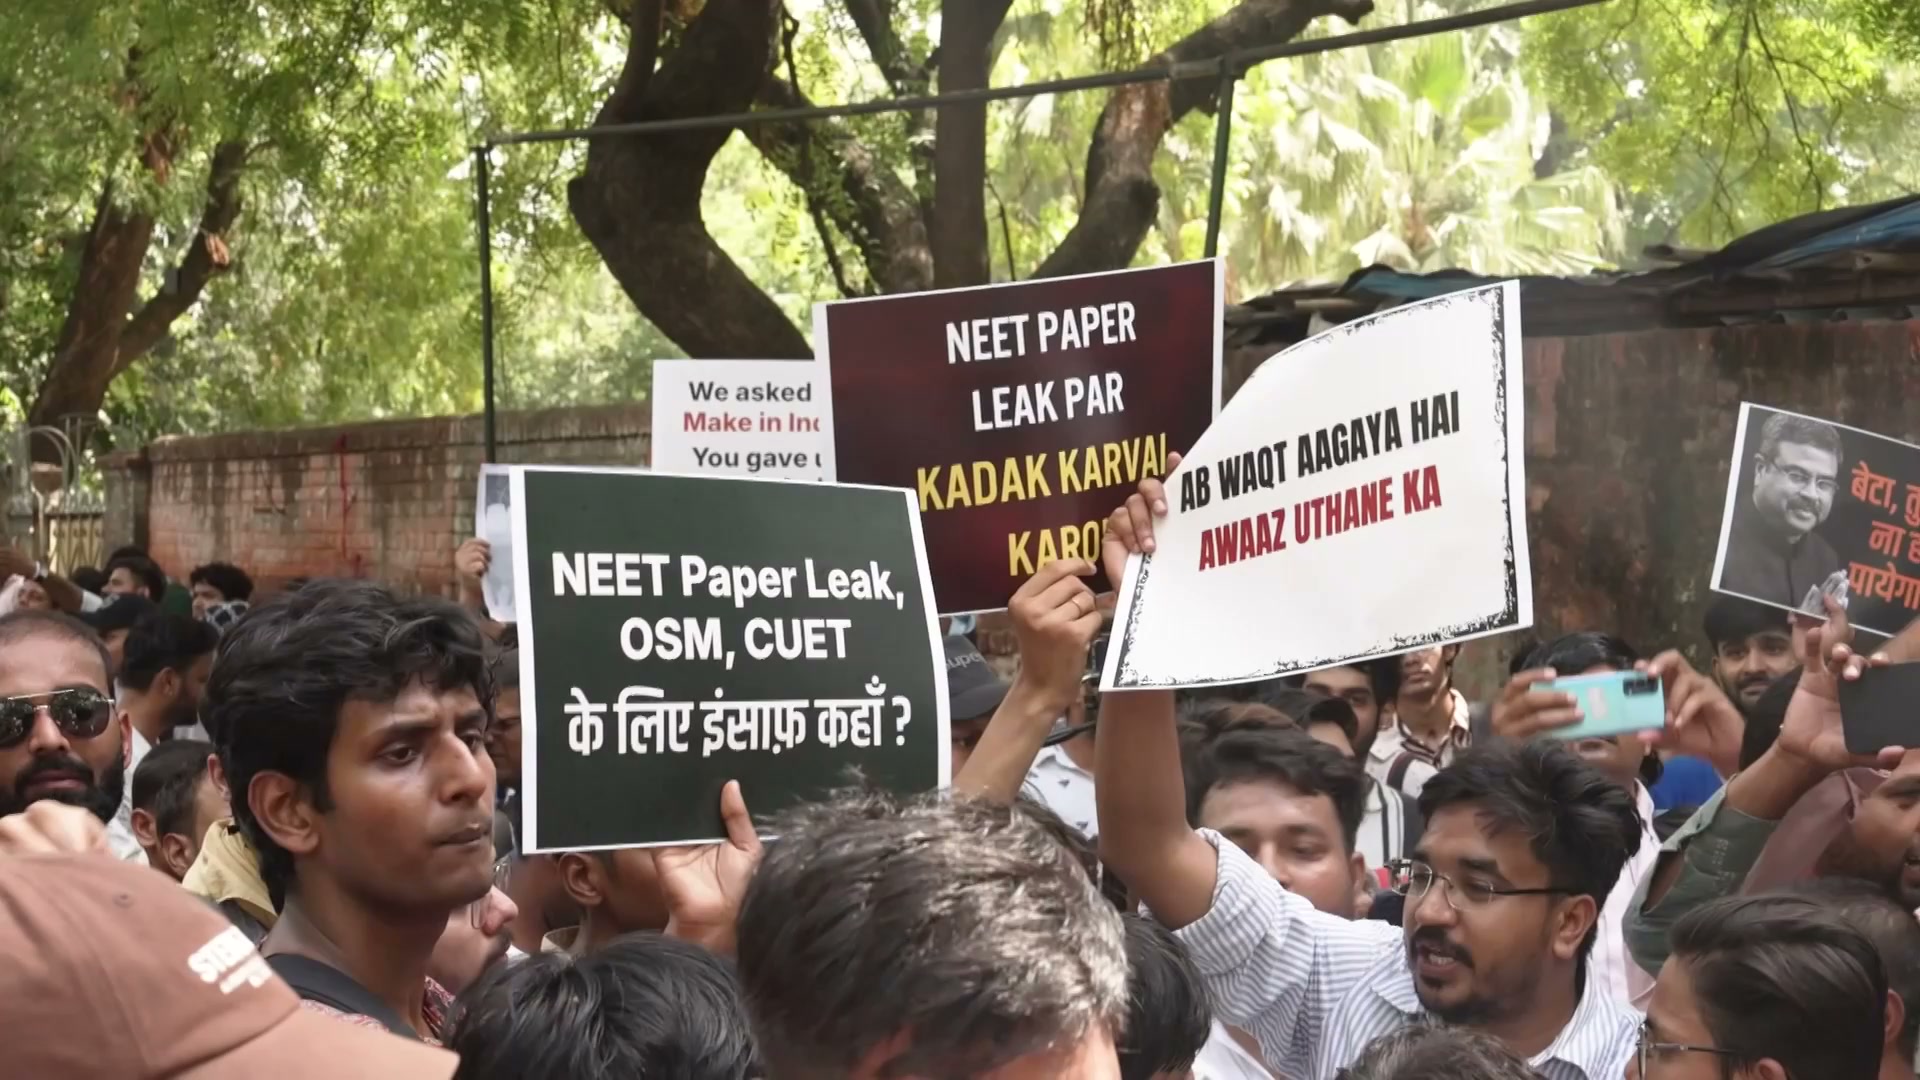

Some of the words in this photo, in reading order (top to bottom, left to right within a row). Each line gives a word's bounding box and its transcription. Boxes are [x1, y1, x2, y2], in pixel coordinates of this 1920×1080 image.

[946, 313, 1030, 364] NEET
[1037, 301, 1137, 353] PAPER
[688, 381, 729, 402] We
[735, 382, 812, 402] asked
[972, 380, 1059, 431] LEAK
[1064, 371, 1125, 420] PAR
[683, 411, 753, 433] Make
[759, 411, 783, 433] in
[692, 447, 739, 468] You
[746, 452, 808, 473] gave
[917, 452, 1049, 512] KADAK
[1058, 431, 1167, 495] KARVAI
[1180, 466, 1211, 514] AB
[1217, 440, 1288, 501] WAQT
[1298, 406, 1403, 478] AAGAYA
[1410, 390, 1460, 444] HAI
[1851, 460, 1898, 515] बेटा,
[1008, 517, 1109, 576] KARO
[1199, 507, 1287, 573] AWAAZ
[1294, 476, 1395, 545] UTHANE
[1402, 464, 1442, 512] KA
[1869, 520, 1906, 558] ना
[551, 551, 671, 597] NEET
[680, 554, 798, 609] Paper
[804, 557, 905, 610] Leak,
[620, 616, 736, 670] OSM,
[744, 617, 852, 660] CUET
[563, 686, 608, 757] के
[612, 685, 695, 756] लिए
[699, 687, 810, 757] इंसाफ़
[813, 674, 887, 748] कहाँ
